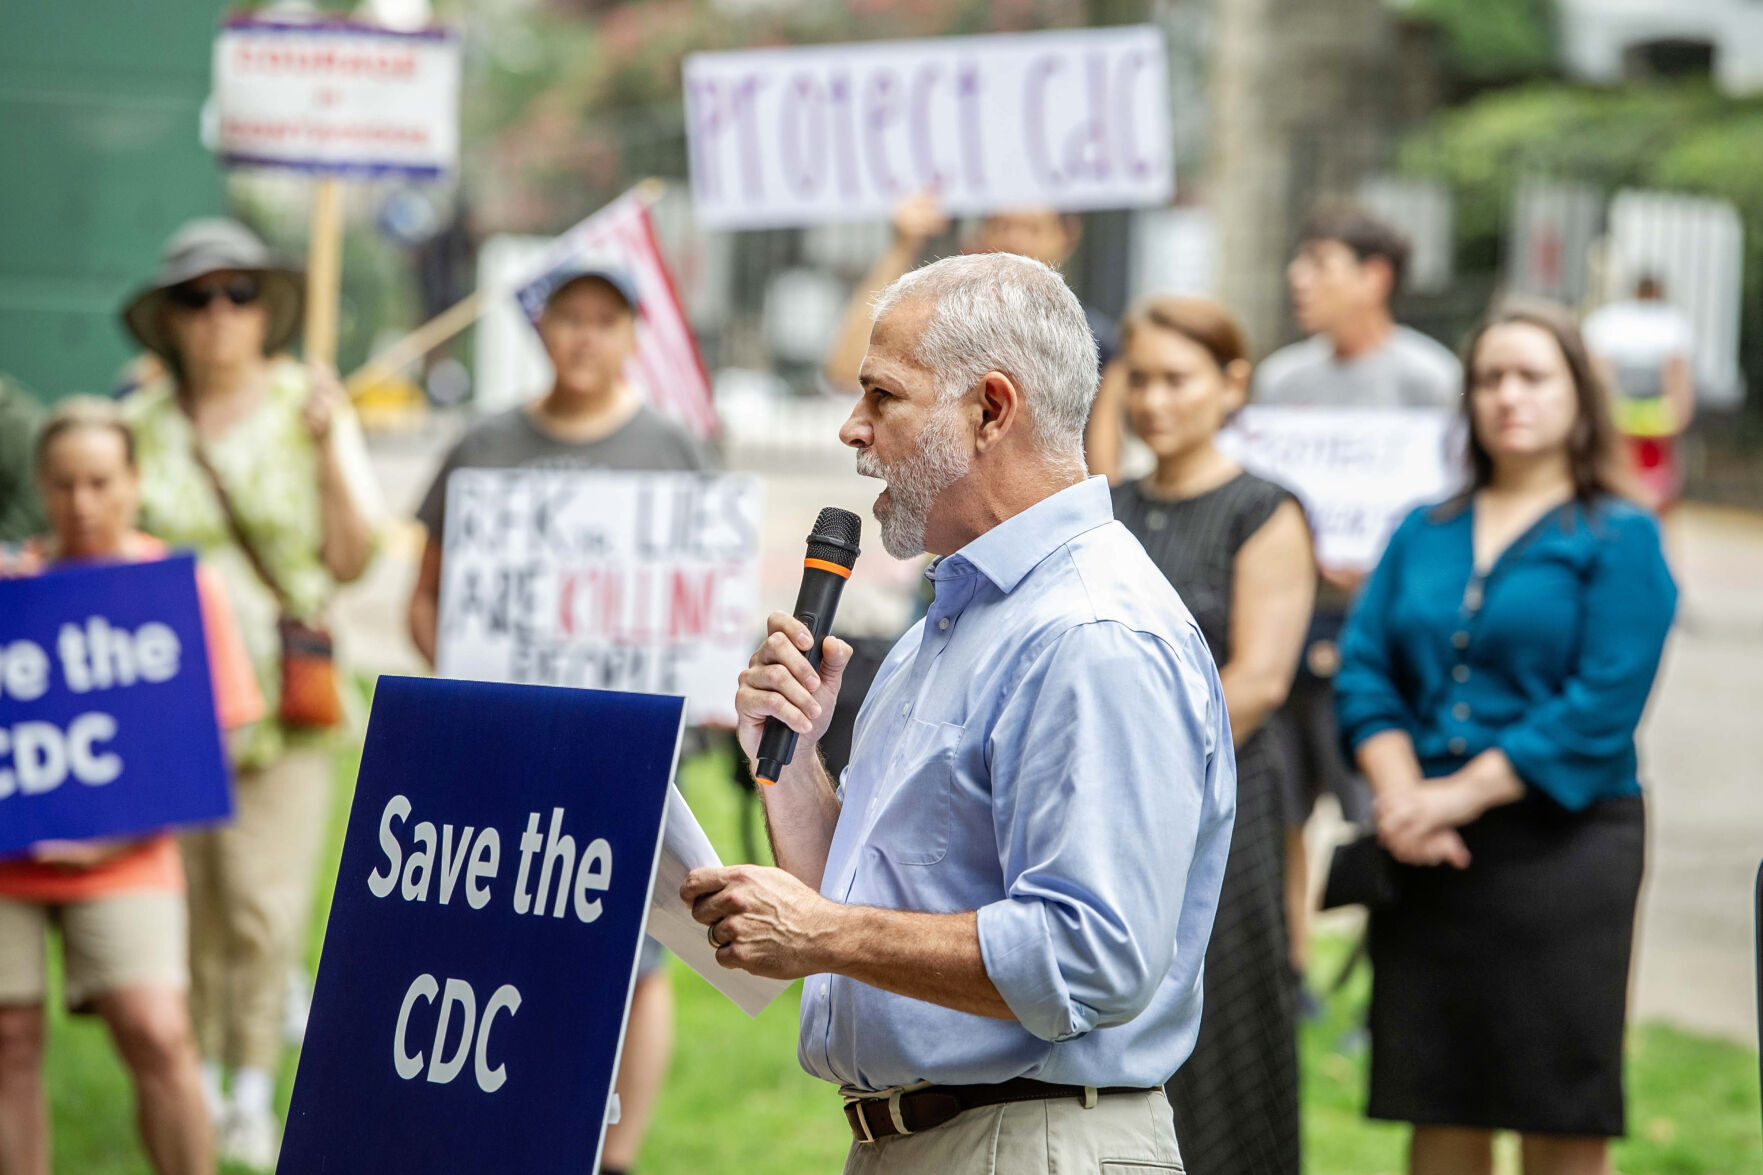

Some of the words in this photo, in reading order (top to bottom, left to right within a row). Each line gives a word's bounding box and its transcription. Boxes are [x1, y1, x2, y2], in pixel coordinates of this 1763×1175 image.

[633, 473, 759, 560] LIES
[450, 561, 541, 638] ARE
[555, 560, 755, 647] KILLING
[57, 614, 182, 695] the
[367, 794, 501, 911] Save
[513, 807, 613, 924] the
[393, 973, 523, 1094] CDC
